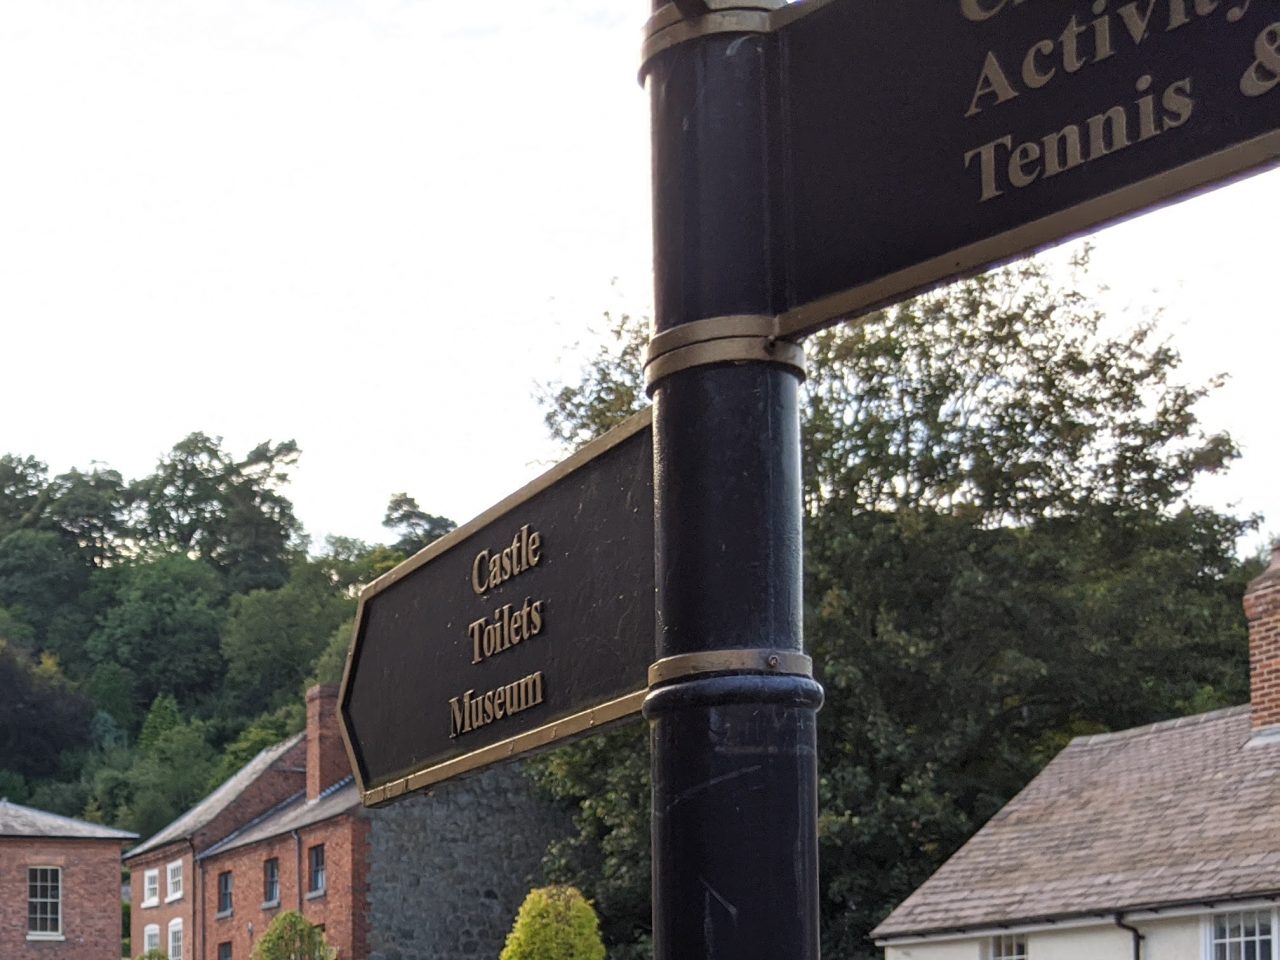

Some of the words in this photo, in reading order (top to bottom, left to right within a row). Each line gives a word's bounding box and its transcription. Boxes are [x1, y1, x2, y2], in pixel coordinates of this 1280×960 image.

[964, 0, 1250, 117] Activ
[964, 75, 1194, 202] Tennis
[1239, 21, 1280, 97] &
[472, 524, 541, 595] Castle
[468, 597, 544, 665] Toilets
[448, 671, 544, 739] Museum
